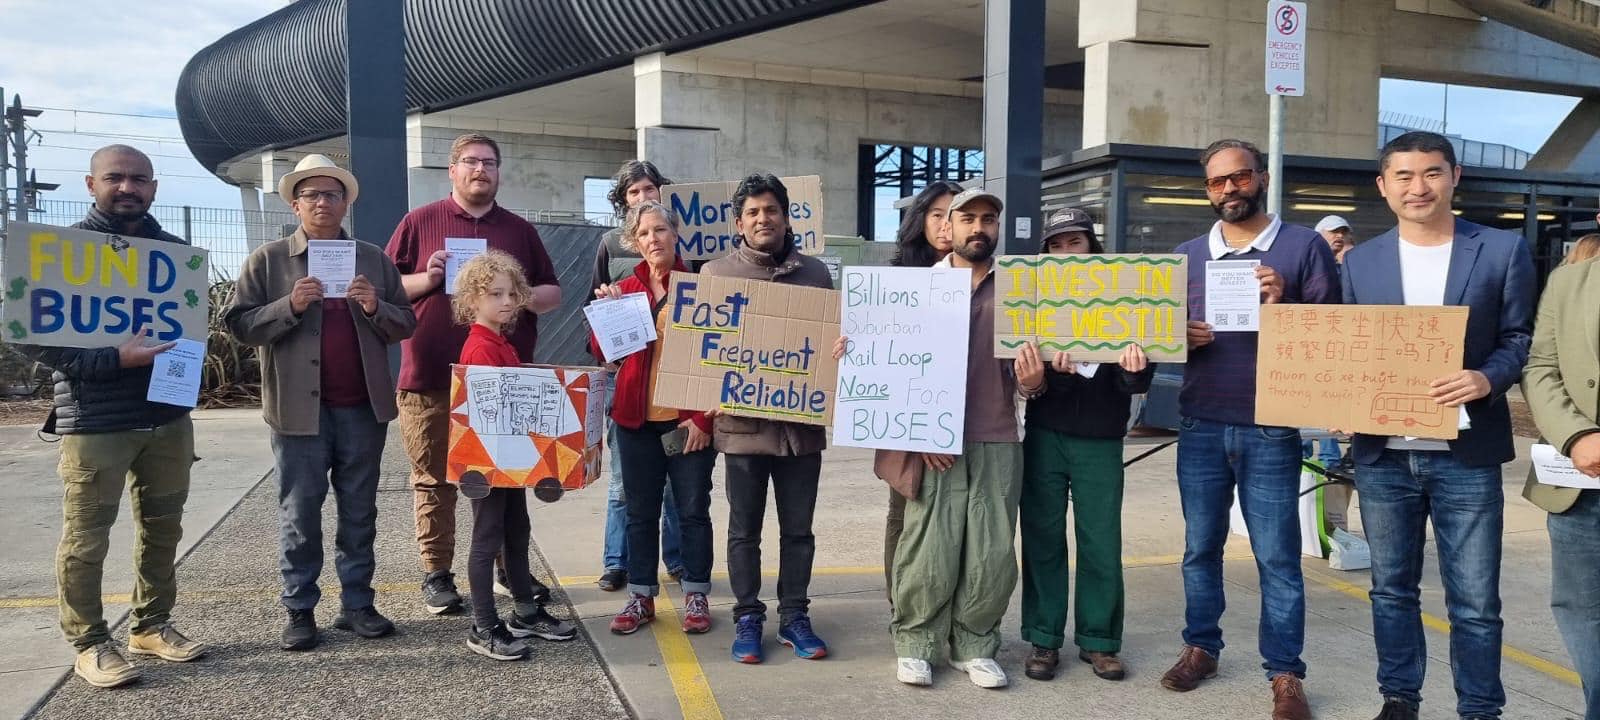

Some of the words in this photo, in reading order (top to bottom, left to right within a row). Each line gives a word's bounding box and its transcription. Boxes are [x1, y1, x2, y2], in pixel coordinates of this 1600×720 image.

[1268, 41, 1302, 50] EMERGENCY
[1272, 51, 1300, 60] VEHICLES
[1271, 61, 1300, 70] EXCEPTED
[670, 191, 733, 226] Mor
[29, 232, 177, 294] FUND
[1007, 264, 1123, 297] INVEST
[1134, 265, 1172, 296] IN
[671, 281, 749, 328] Fast
[846, 272, 919, 308] Billions
[928, 272, 965, 308] For
[31, 288, 183, 341] BUSES
[846, 311, 922, 336] Suburban
[1005, 306, 1057, 337] THE
[1071, 306, 1175, 344] WEST!!
[701, 333, 815, 373] Frequent
[843, 339, 878, 367] Rail
[888, 339, 933, 377] Loop
[721, 370, 826, 413] Reliable
[839, 375, 890, 397] None
[906, 377, 949, 406] For
[852, 408, 955, 448] BUSES
